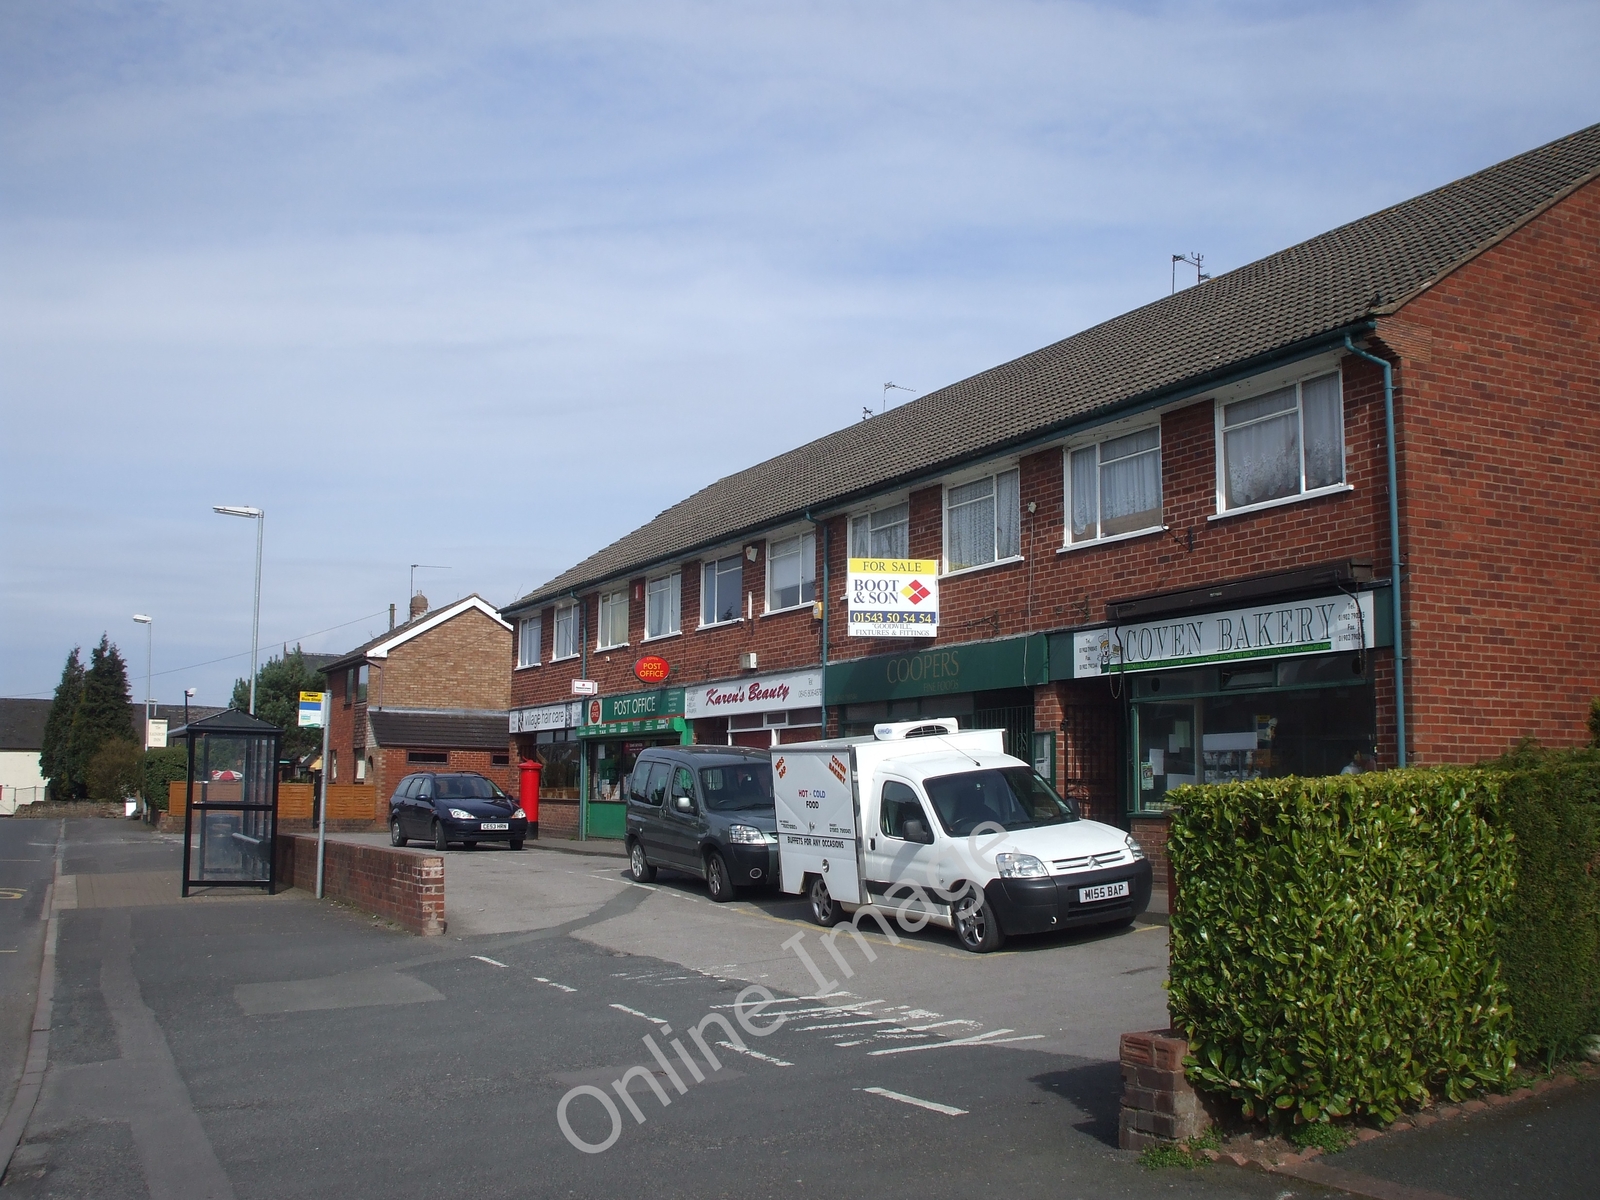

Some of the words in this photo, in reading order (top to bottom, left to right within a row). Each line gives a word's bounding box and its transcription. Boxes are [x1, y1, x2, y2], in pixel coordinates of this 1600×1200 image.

[863, 561, 886, 571] FOR
[892, 562, 922, 572] SALE
[854, 579, 899, 591] BOOT
[854, 592, 865, 603] &
[869, 592, 899, 604] SON
[853, 612, 883, 623] 01543
[887, 613, 900, 623] 50
[903, 613, 915, 624] 54
[919, 614, 931, 624] 54
[1124, 621, 1203, 662] COVEN
[1217, 603, 1336, 652] BAKERY
[887, 651, 959, 683] COOPERS
[706, 686, 745, 706] Karen's
[748, 683, 790, 702] Beauty
[614, 700, 631, 715] POST
[632, 697, 656, 714] OFFICE
[552, 711, 564, 724] care
[832, 755, 847, 775] COVEN
[829, 762, 846, 784] BAKERY
[798, 790, 808, 798] HOT
[813, 790, 826, 798] COLD
[806, 801, 819, 809] FOOD
[787, 836, 803, 845] BUFFETS
[804, 838, 812, 846] FOR
[821, 839, 845, 849] OCCASIONS
[1107, 884, 1124, 896] BAP
